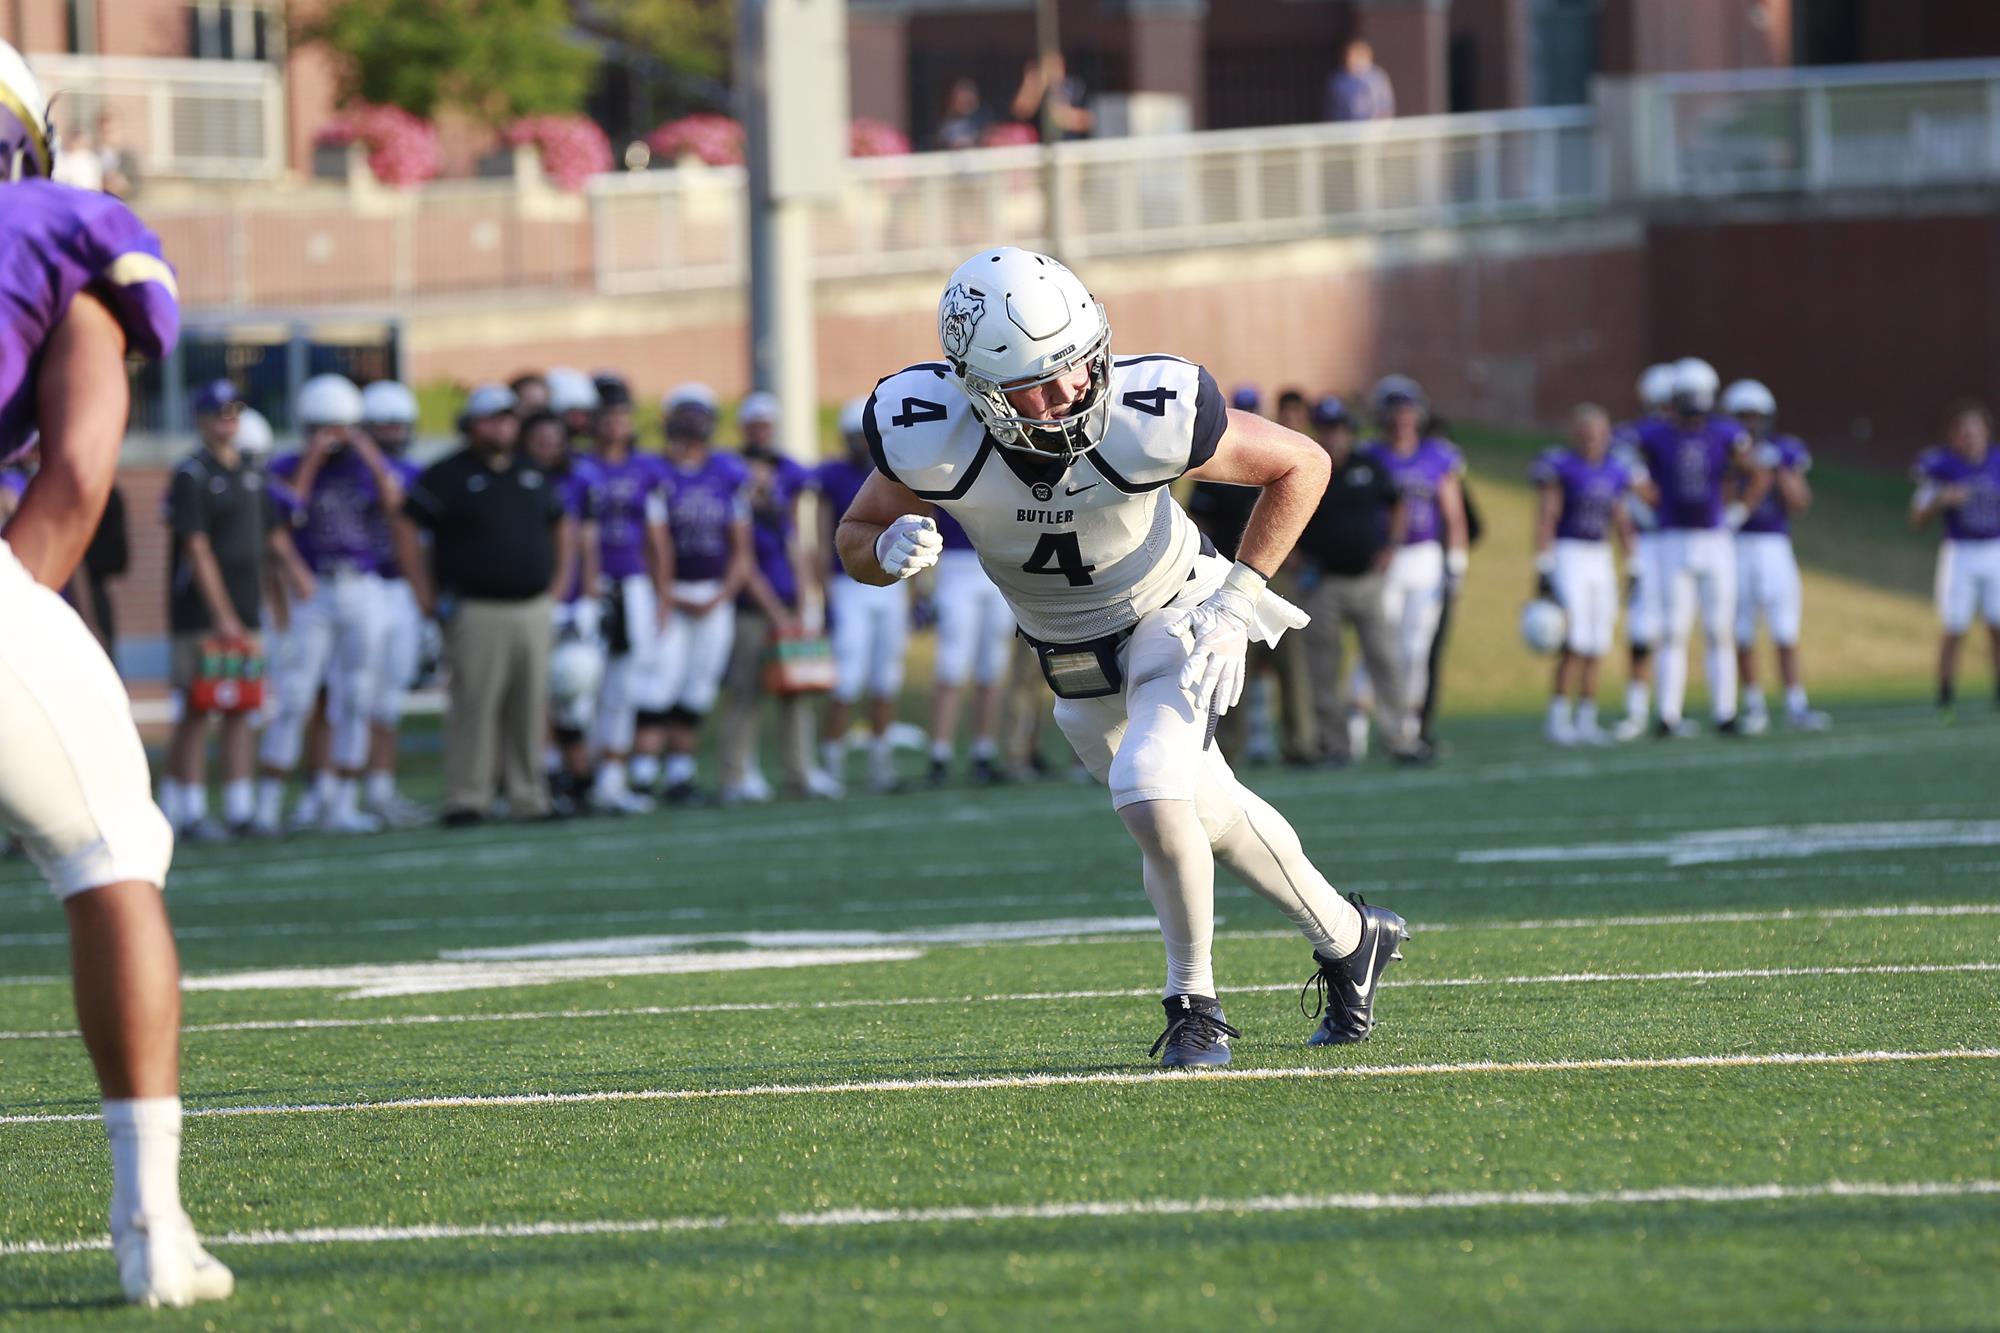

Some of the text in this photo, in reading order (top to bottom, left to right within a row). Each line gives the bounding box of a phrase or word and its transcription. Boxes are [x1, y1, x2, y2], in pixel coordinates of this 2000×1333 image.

[892, 397, 948, 428] 4
[1122, 387, 1177, 416] 4
[1016, 509, 1074, 525] BUTLER
[1021, 531, 1096, 587] 4
